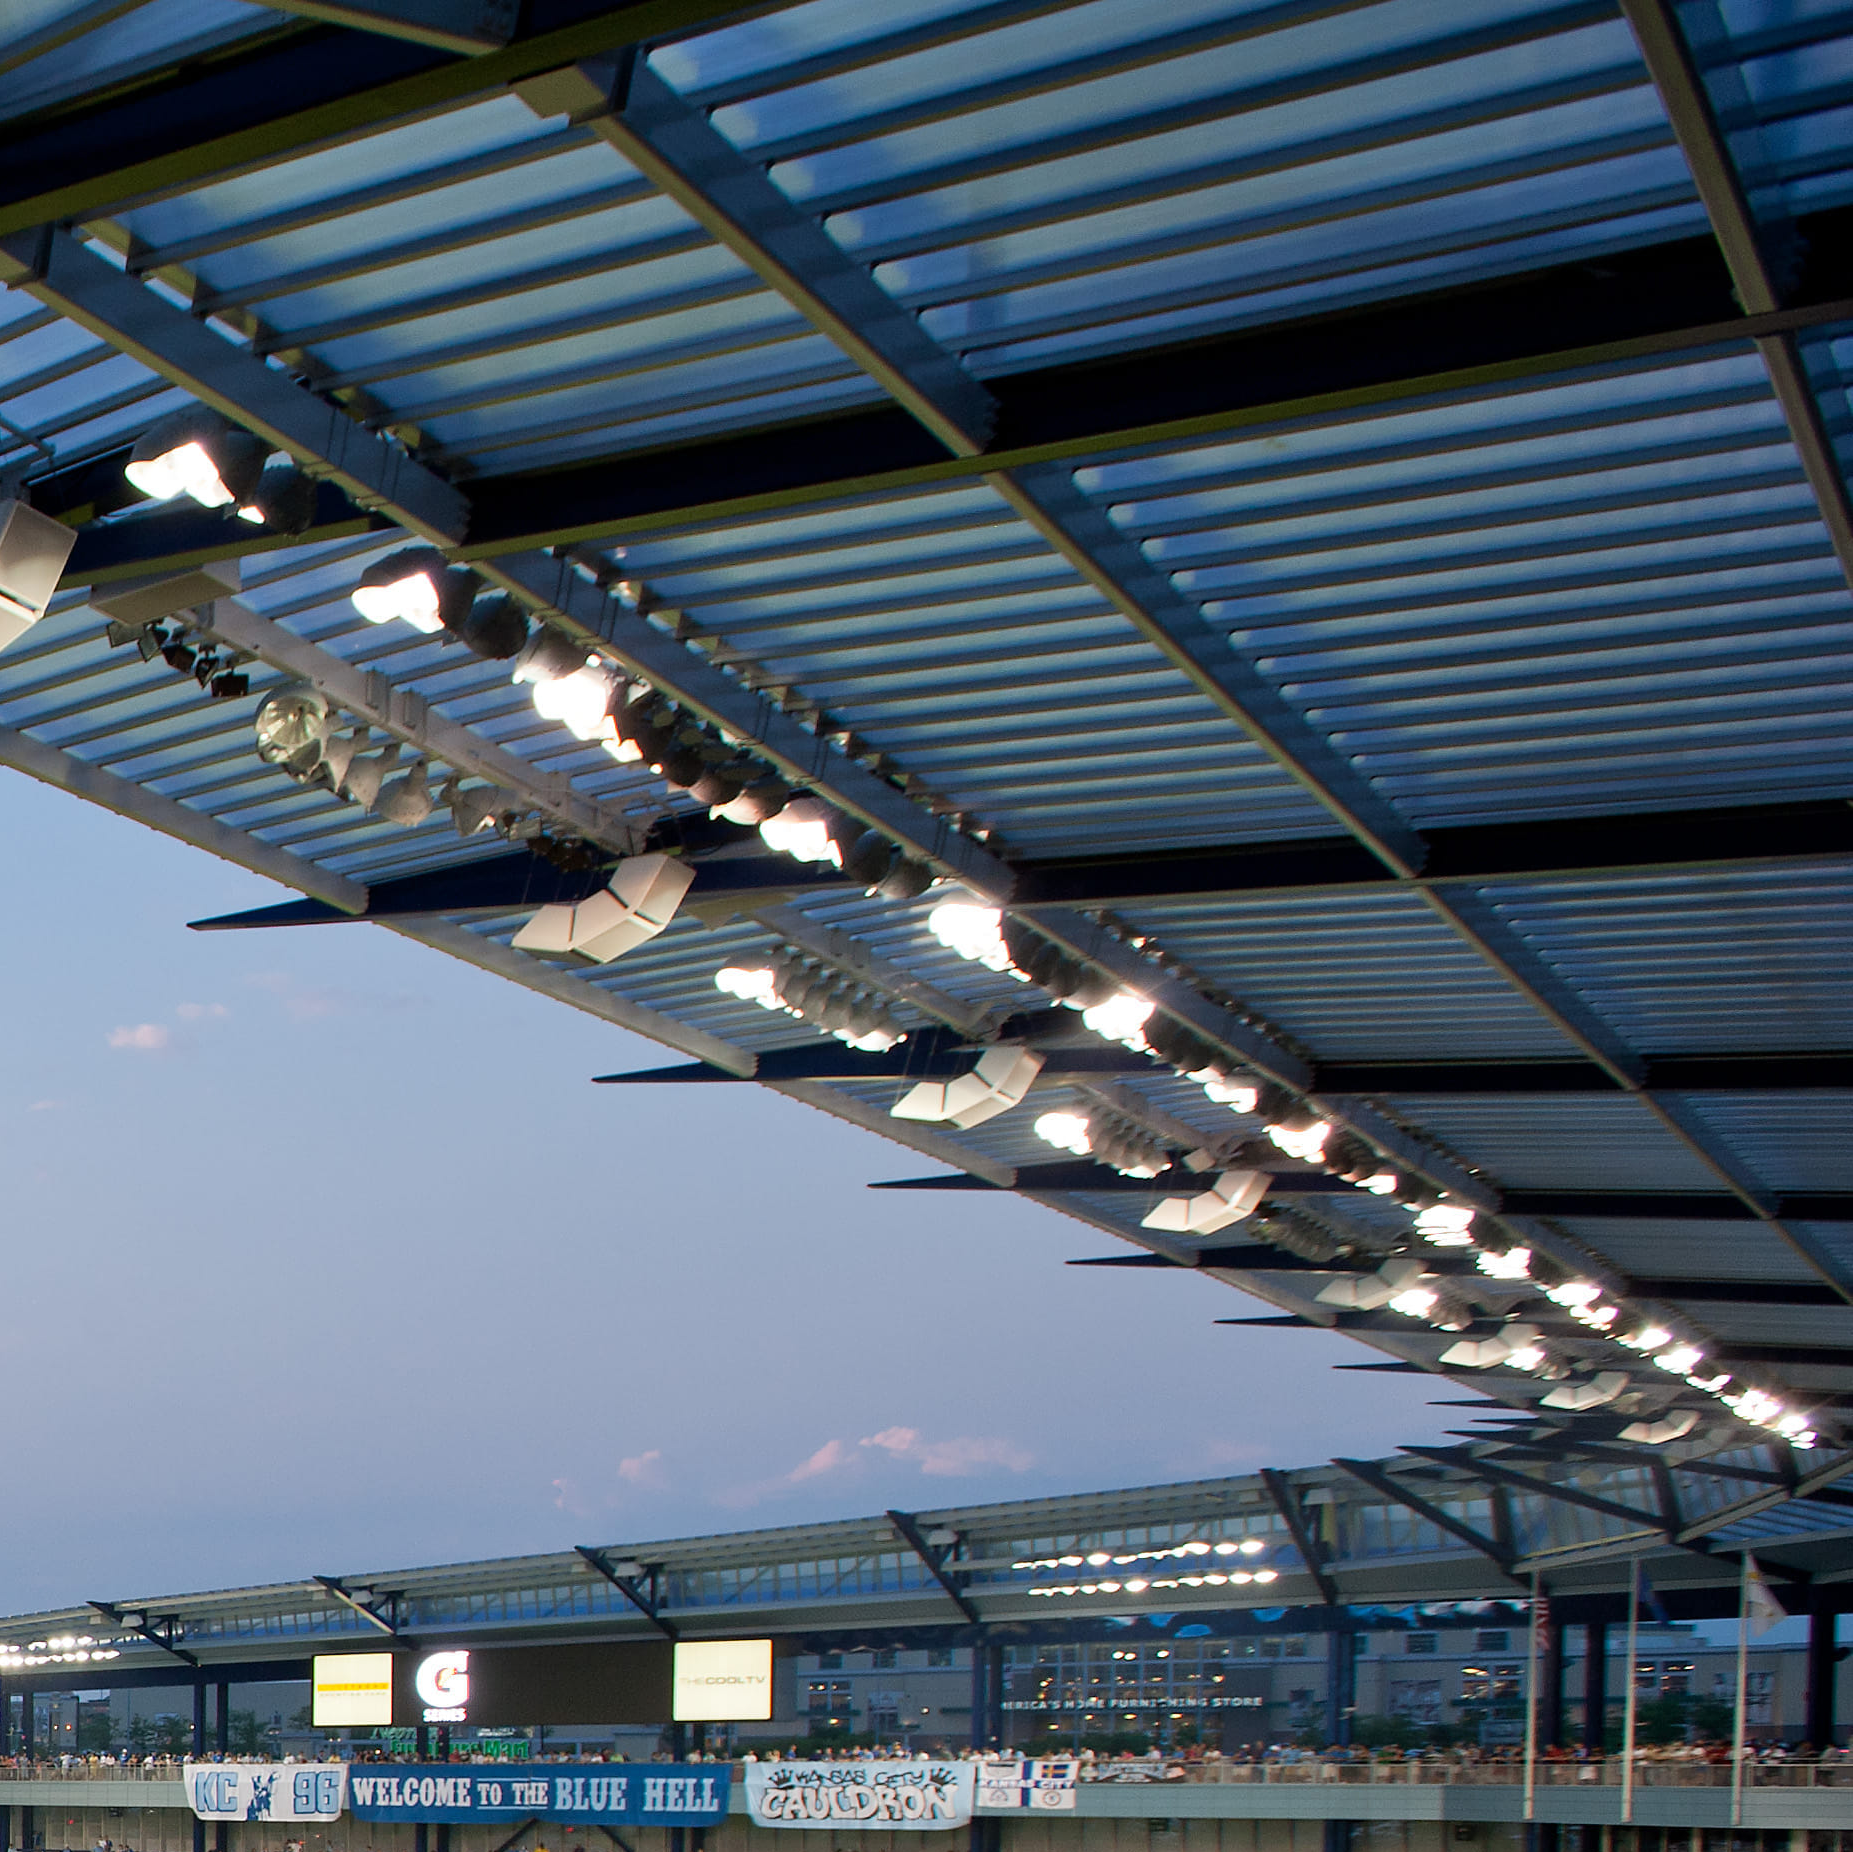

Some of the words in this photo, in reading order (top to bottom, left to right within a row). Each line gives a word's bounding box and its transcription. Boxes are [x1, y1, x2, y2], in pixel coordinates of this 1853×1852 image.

[415, 1650, 471, 1708] G
[196, 1772, 238, 1812] KC
[294, 1771, 341, 1814] 96
[352, 1777, 471, 1807] WELCOME
[477, 1783, 502, 1806] TO
[512, 1782, 548, 1806] THE
[554, 1777, 628, 1811] BLUE
[643, 1777, 719, 1812] HELL
[796, 1768, 866, 1786] KANSAS
[875, 1769, 923, 1786] CITY
[761, 1783, 958, 1821] CAULDRON
